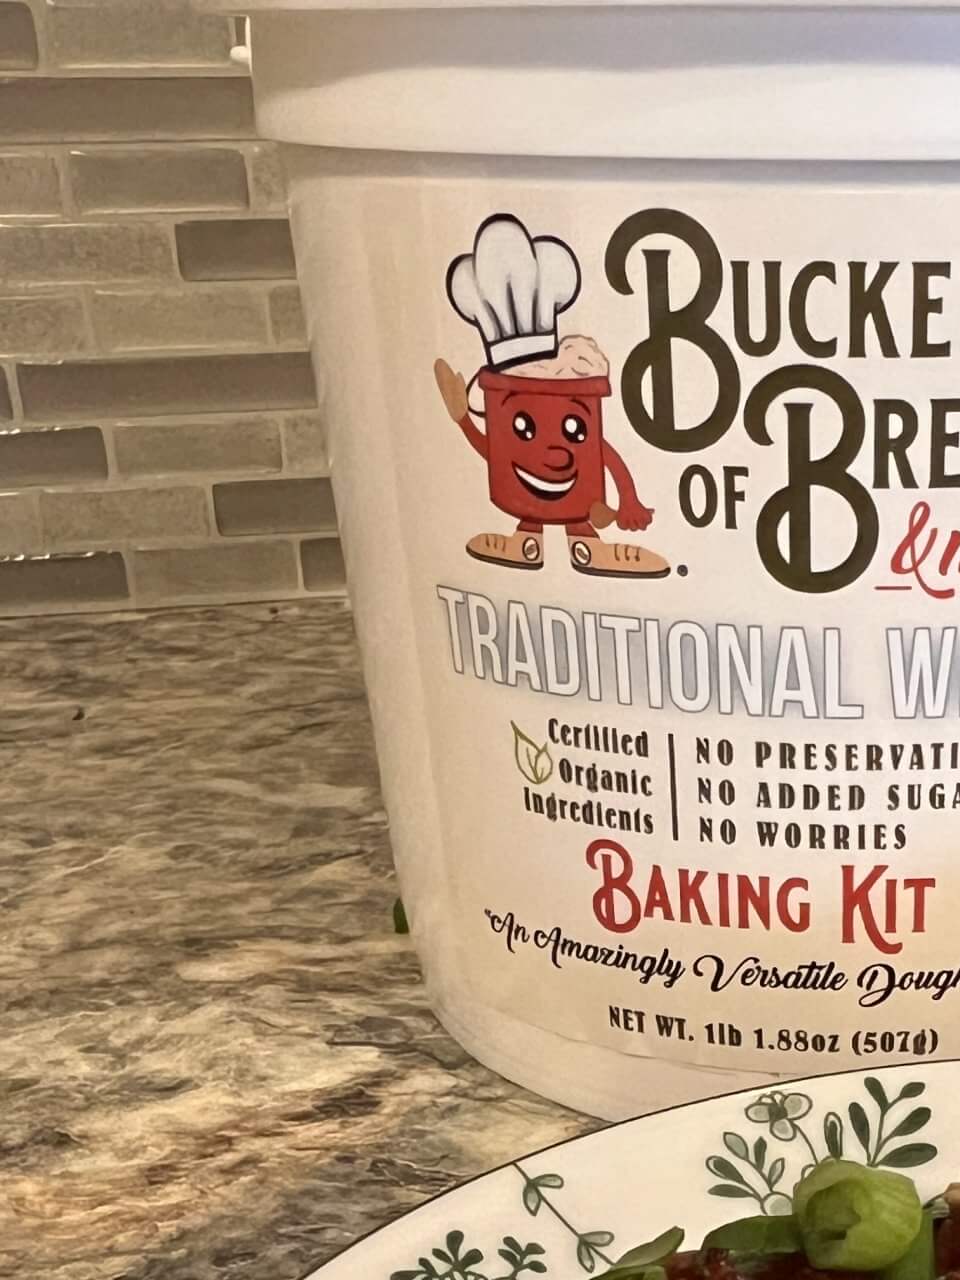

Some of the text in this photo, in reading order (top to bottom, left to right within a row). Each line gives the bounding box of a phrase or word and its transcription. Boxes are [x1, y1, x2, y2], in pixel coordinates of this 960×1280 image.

[677, 463, 750, 530] OF
[436, 585, 865, 720] TRADITIONAL
[547, 717, 649, 758] Certified
[695, 736, 735, 767] NO
[558, 757, 653, 797] Organic
[697, 777, 736, 807] NO
[756, 781, 867, 811] ADDED
[523, 786, 654, 835] Ingredients
[699, 818, 908, 851] NO WORRIES
[585, 838, 936, 955] BAKING KIT
[532, 926, 687, 989] Amazingly
[692, 953, 849, 994] Versatile
[608, 1004, 646, 1034] NET
[654, 1013, 695, 1042] WT.
[703, 1022, 743, 1047] 1lb
[752, 1027, 841, 1053] 1.88oz
